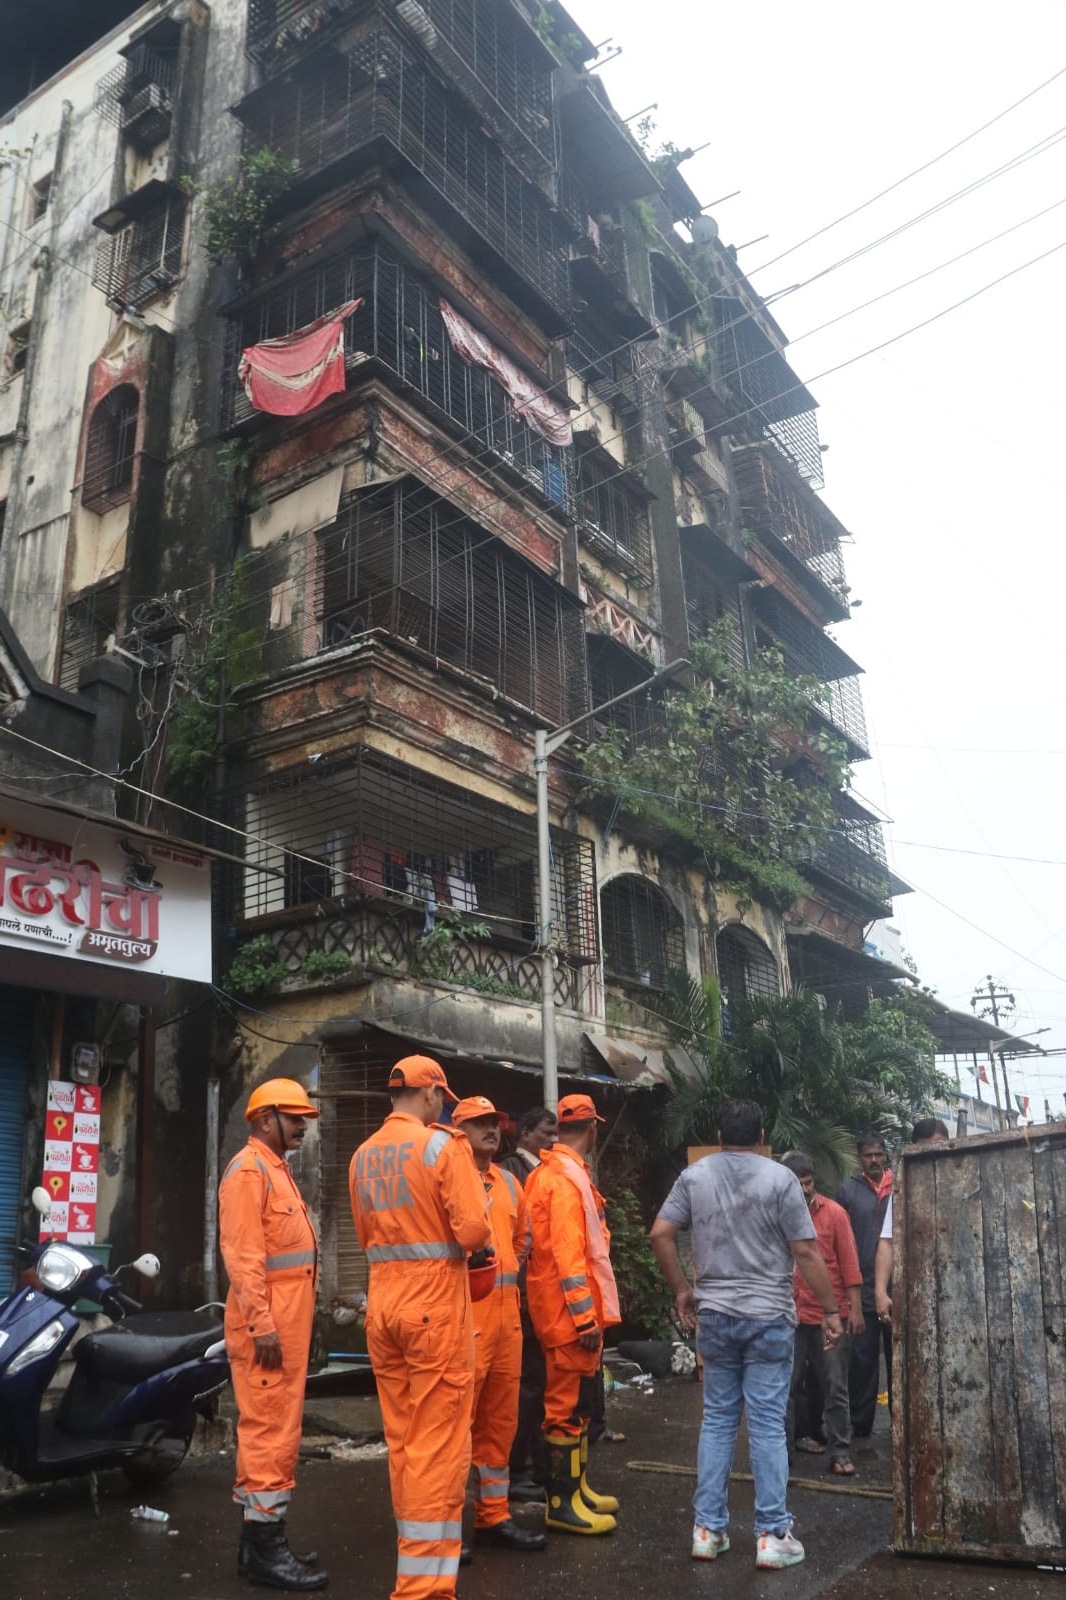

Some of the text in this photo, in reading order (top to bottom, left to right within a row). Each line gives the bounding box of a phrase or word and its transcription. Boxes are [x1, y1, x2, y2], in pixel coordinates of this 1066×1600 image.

[0, 855, 162, 941] ढरीचा
[89, 932, 151, 956] अमृततुल्य
[354, 1141, 414, 1178] NDRF
[356, 1175, 414, 1212] INDIA
